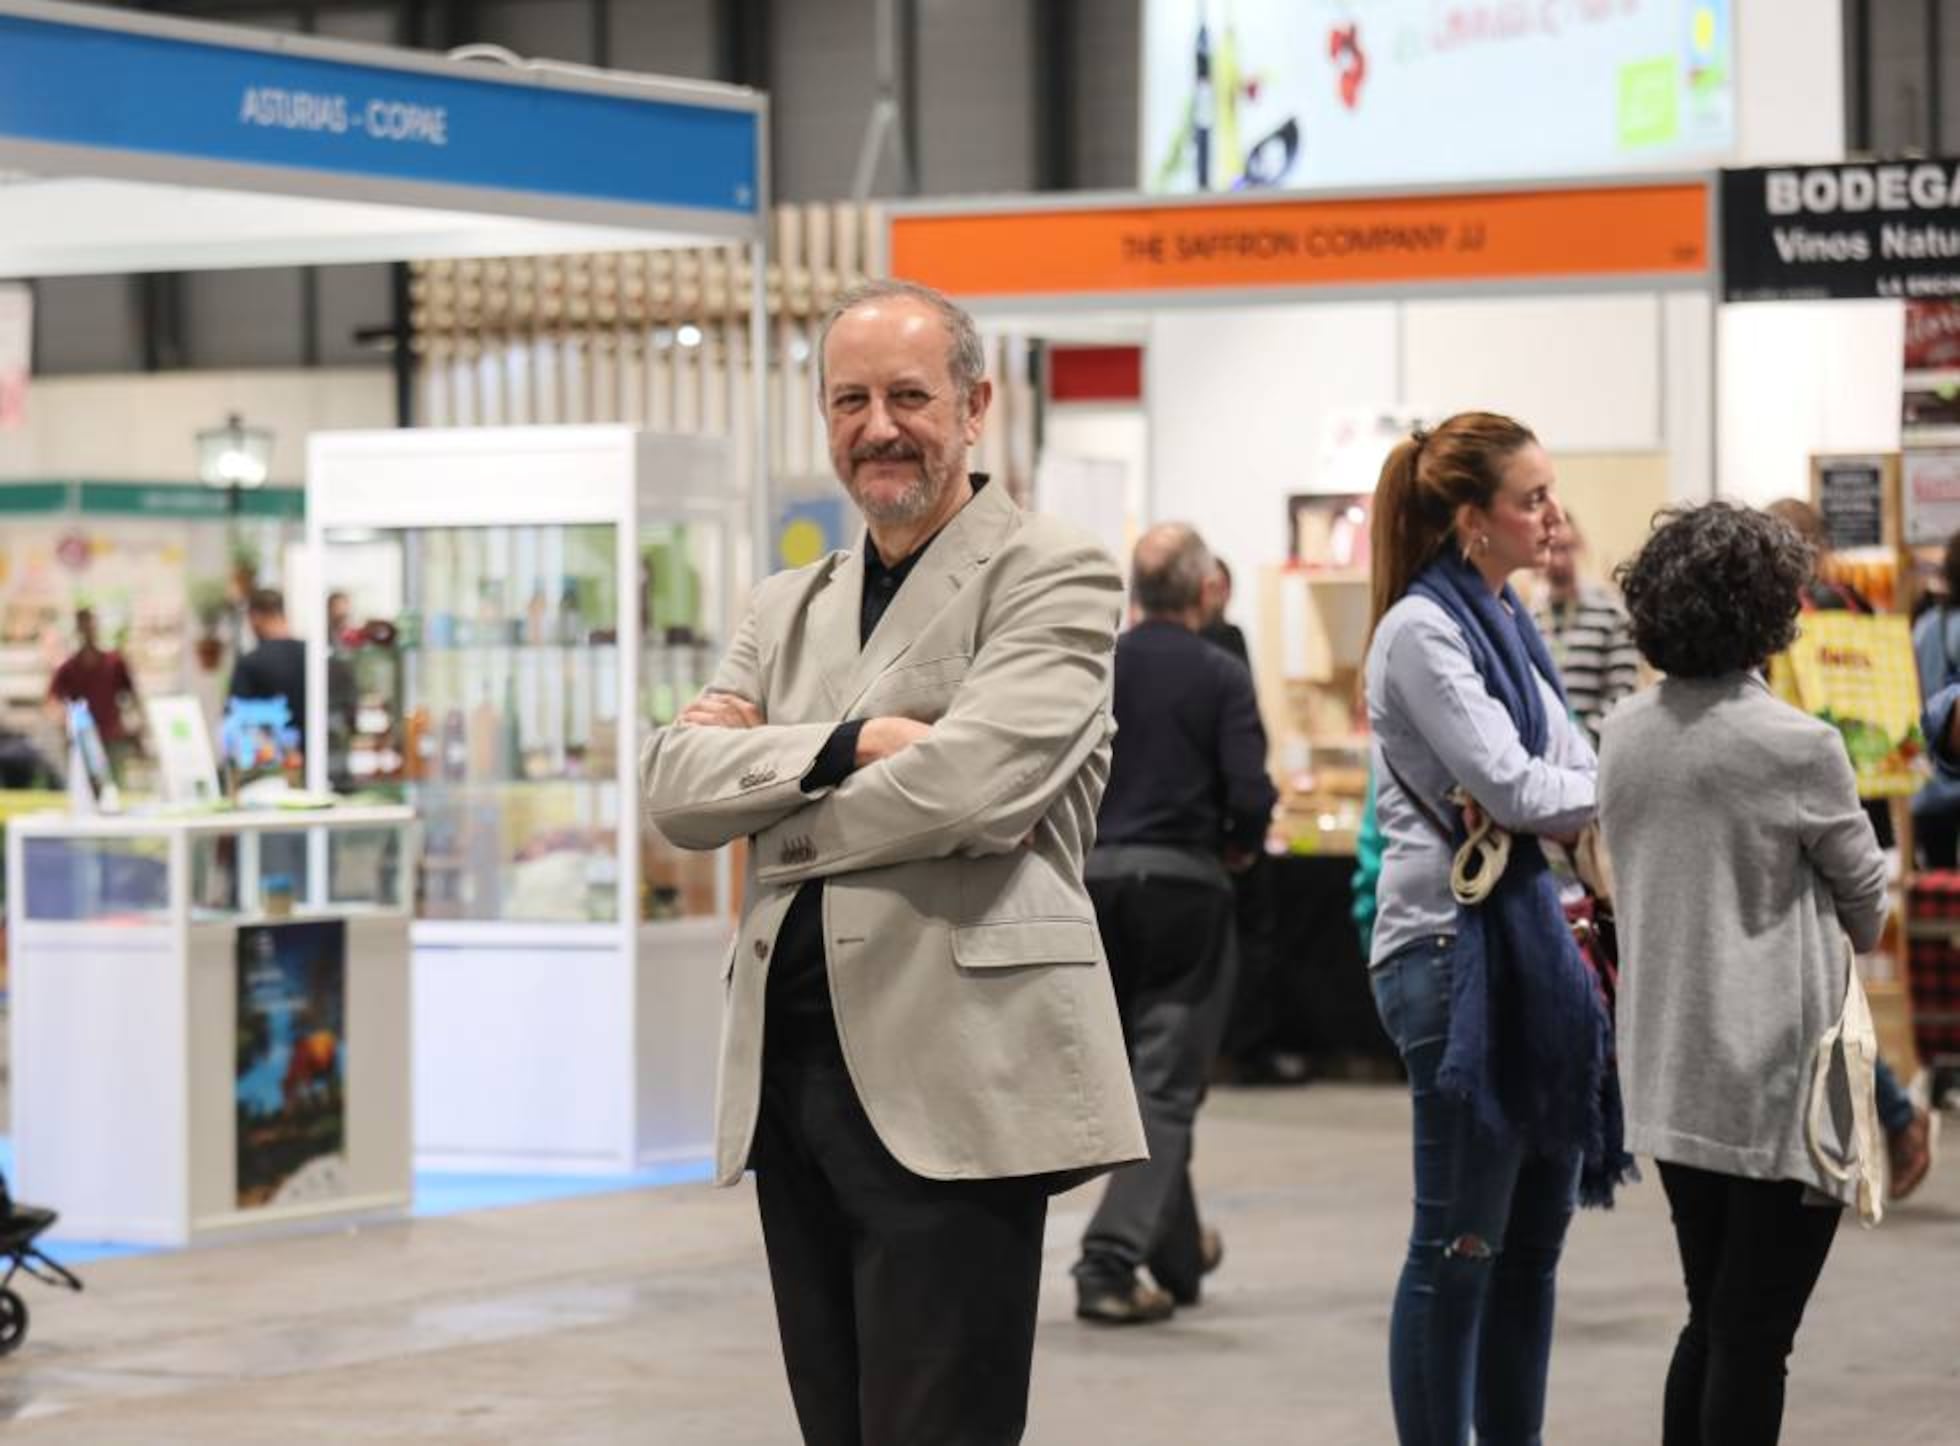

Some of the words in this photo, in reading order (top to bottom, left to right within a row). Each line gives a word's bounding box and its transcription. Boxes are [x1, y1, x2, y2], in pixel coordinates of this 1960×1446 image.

[241, 86, 347, 133] ASTURIAS
[1121, 231, 1164, 263] THE
[1174, 225, 1299, 262] SAFFRON
[1304, 219, 1448, 259] COMPANY
[1773, 226, 1869, 263] Vinos
